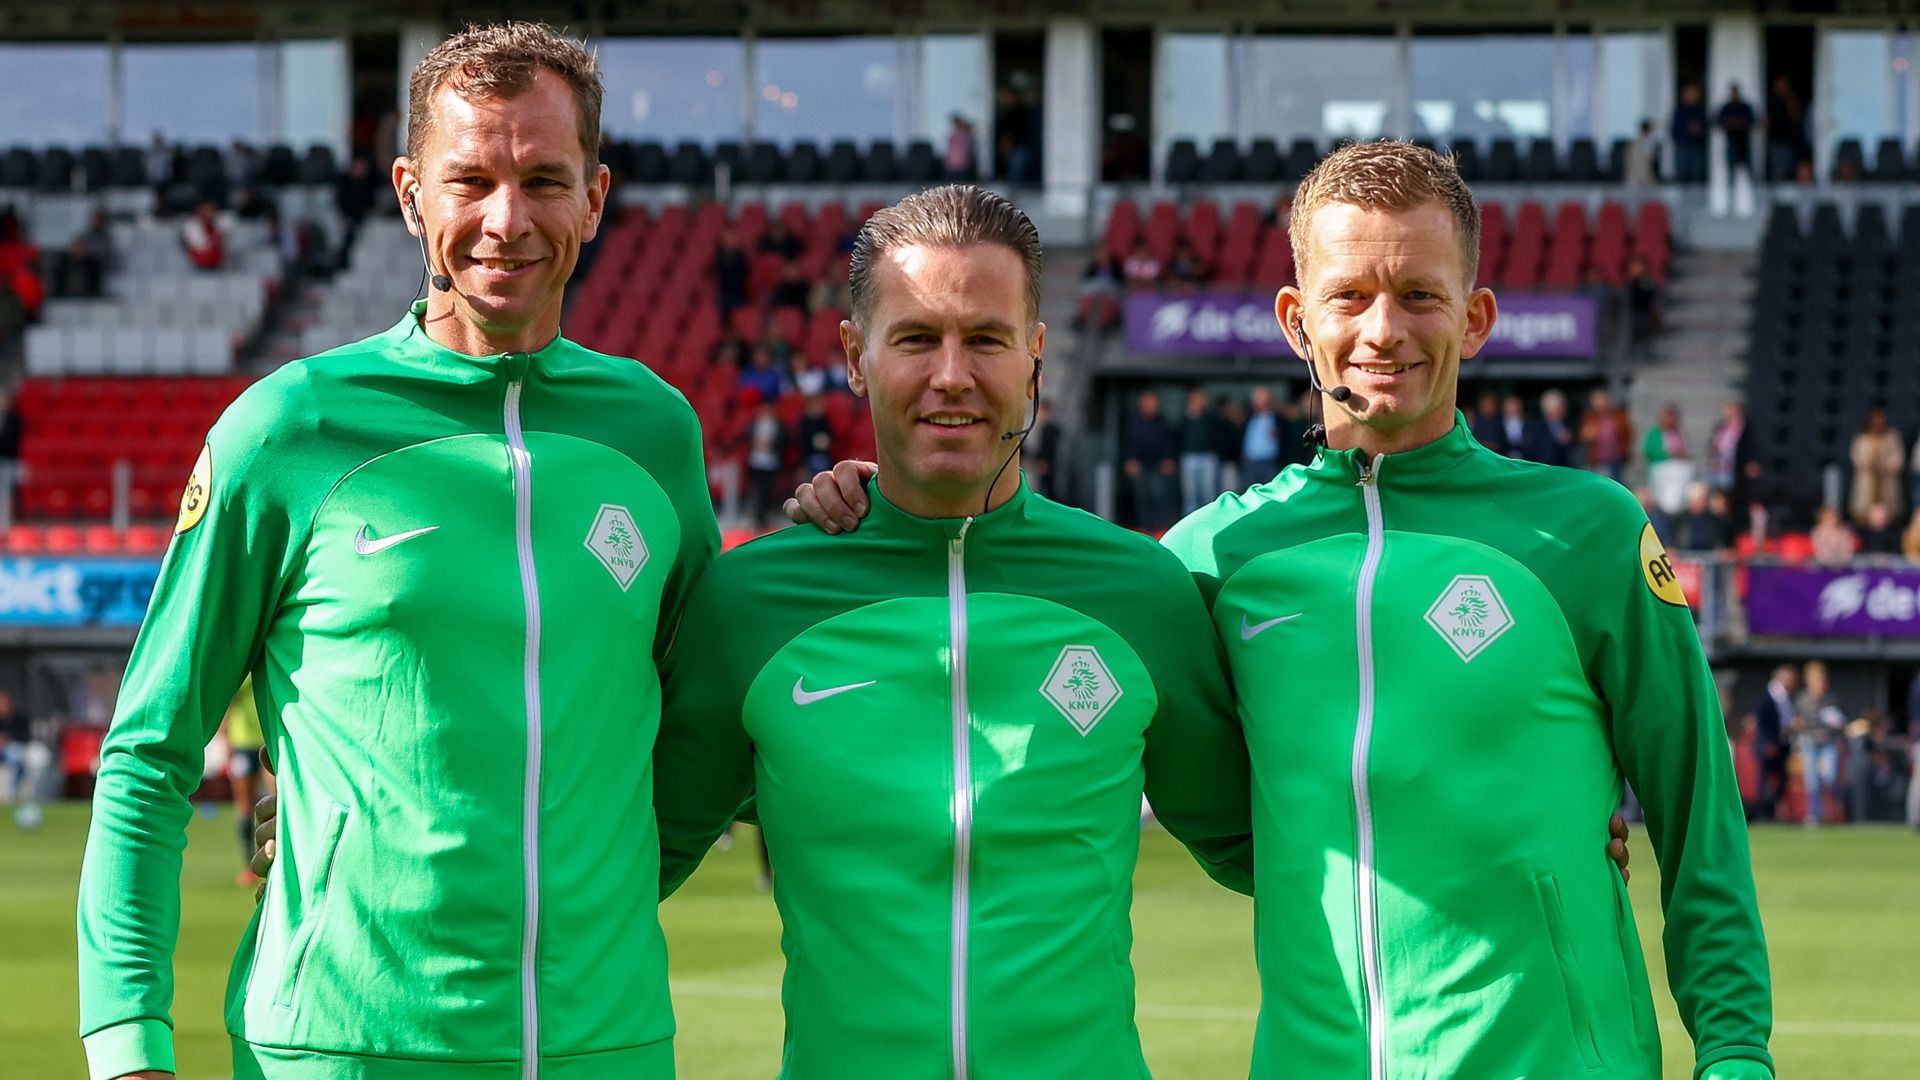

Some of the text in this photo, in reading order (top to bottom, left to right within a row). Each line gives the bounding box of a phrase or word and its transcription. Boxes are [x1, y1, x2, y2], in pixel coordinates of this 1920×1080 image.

[610, 556, 634, 568] KNVB
[1866, 576, 1915, 621] de
[1453, 627, 1485, 638] KNVB
[1068, 700, 1099, 711] KNVB
